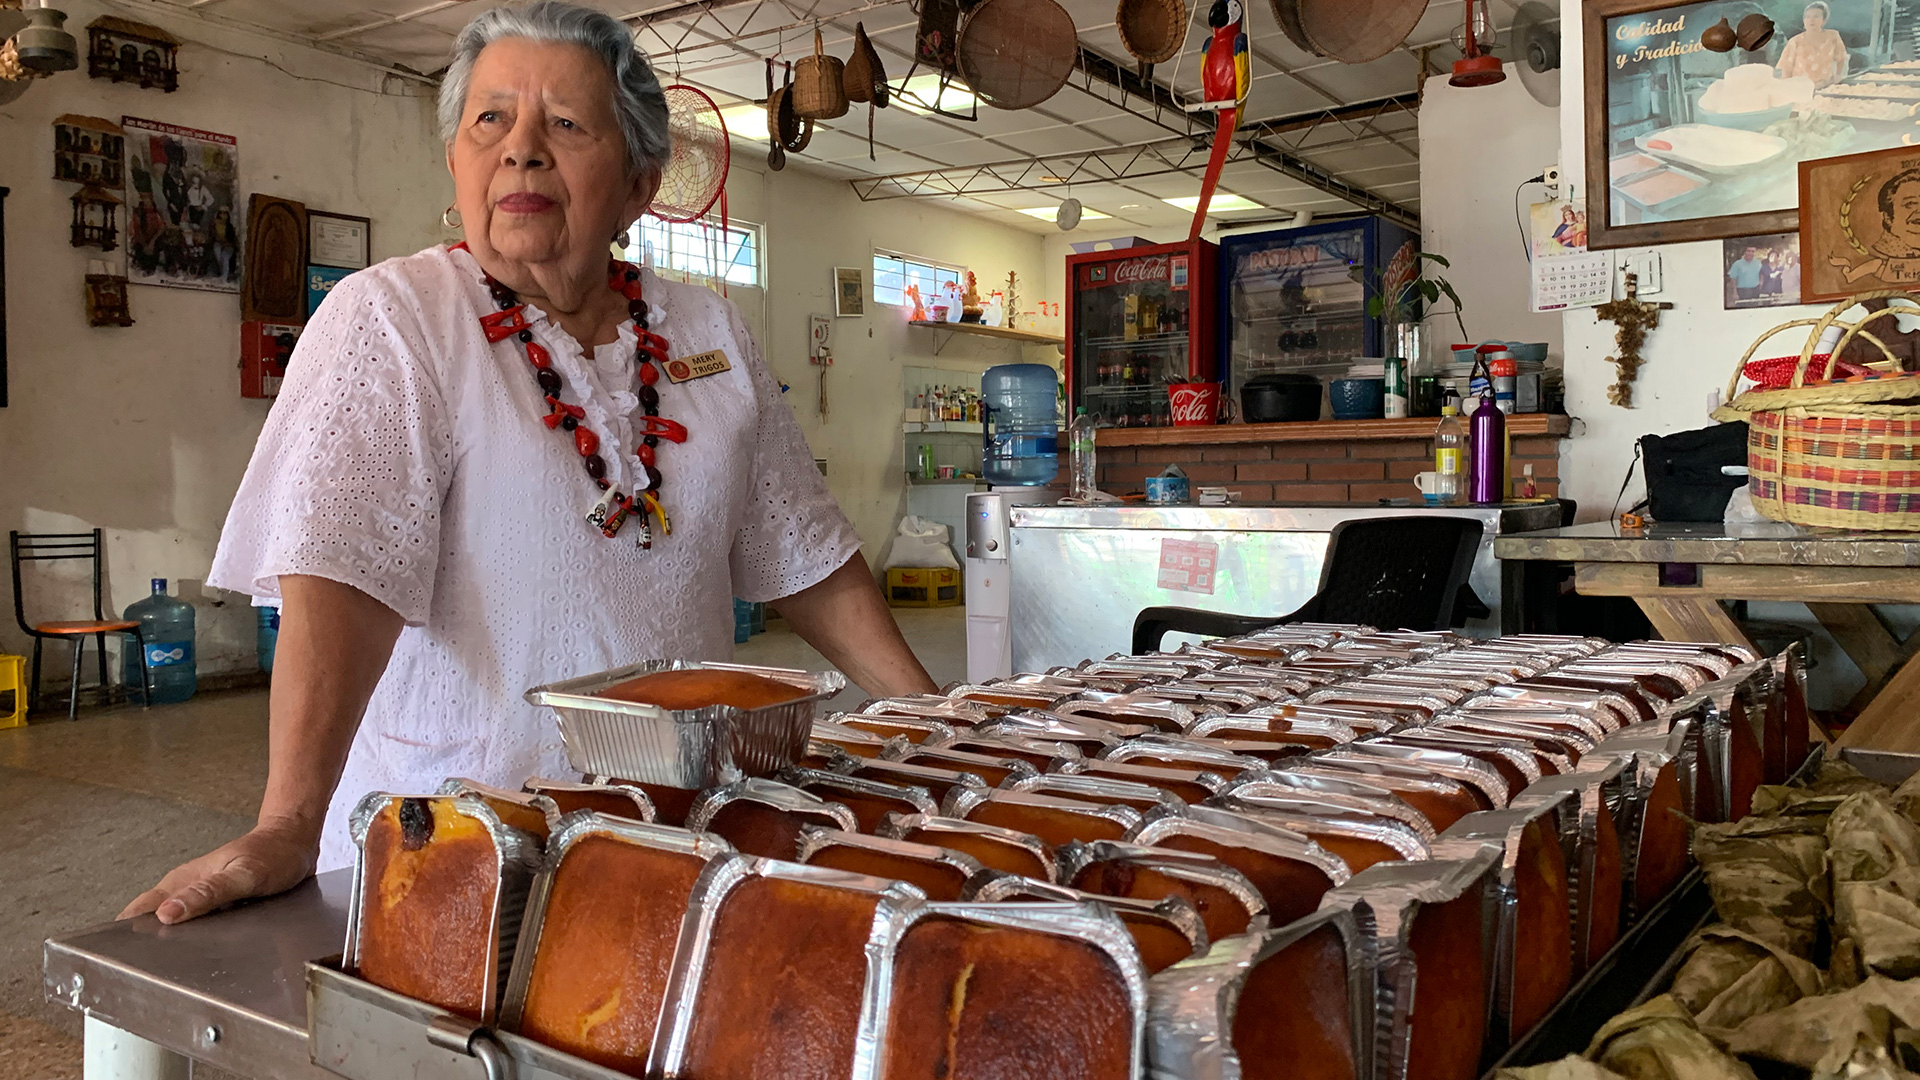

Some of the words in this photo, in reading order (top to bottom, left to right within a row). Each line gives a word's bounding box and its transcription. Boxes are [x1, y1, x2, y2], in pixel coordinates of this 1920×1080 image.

[1616, 15, 1685, 40] Calidad
[1616, 54, 1628, 69] y
[1633, 40, 1707, 63] Tradició
[692, 354, 715, 365] MERY
[693, 361, 725, 375] TRIGOS
[1171, 389, 1212, 421] Cola
